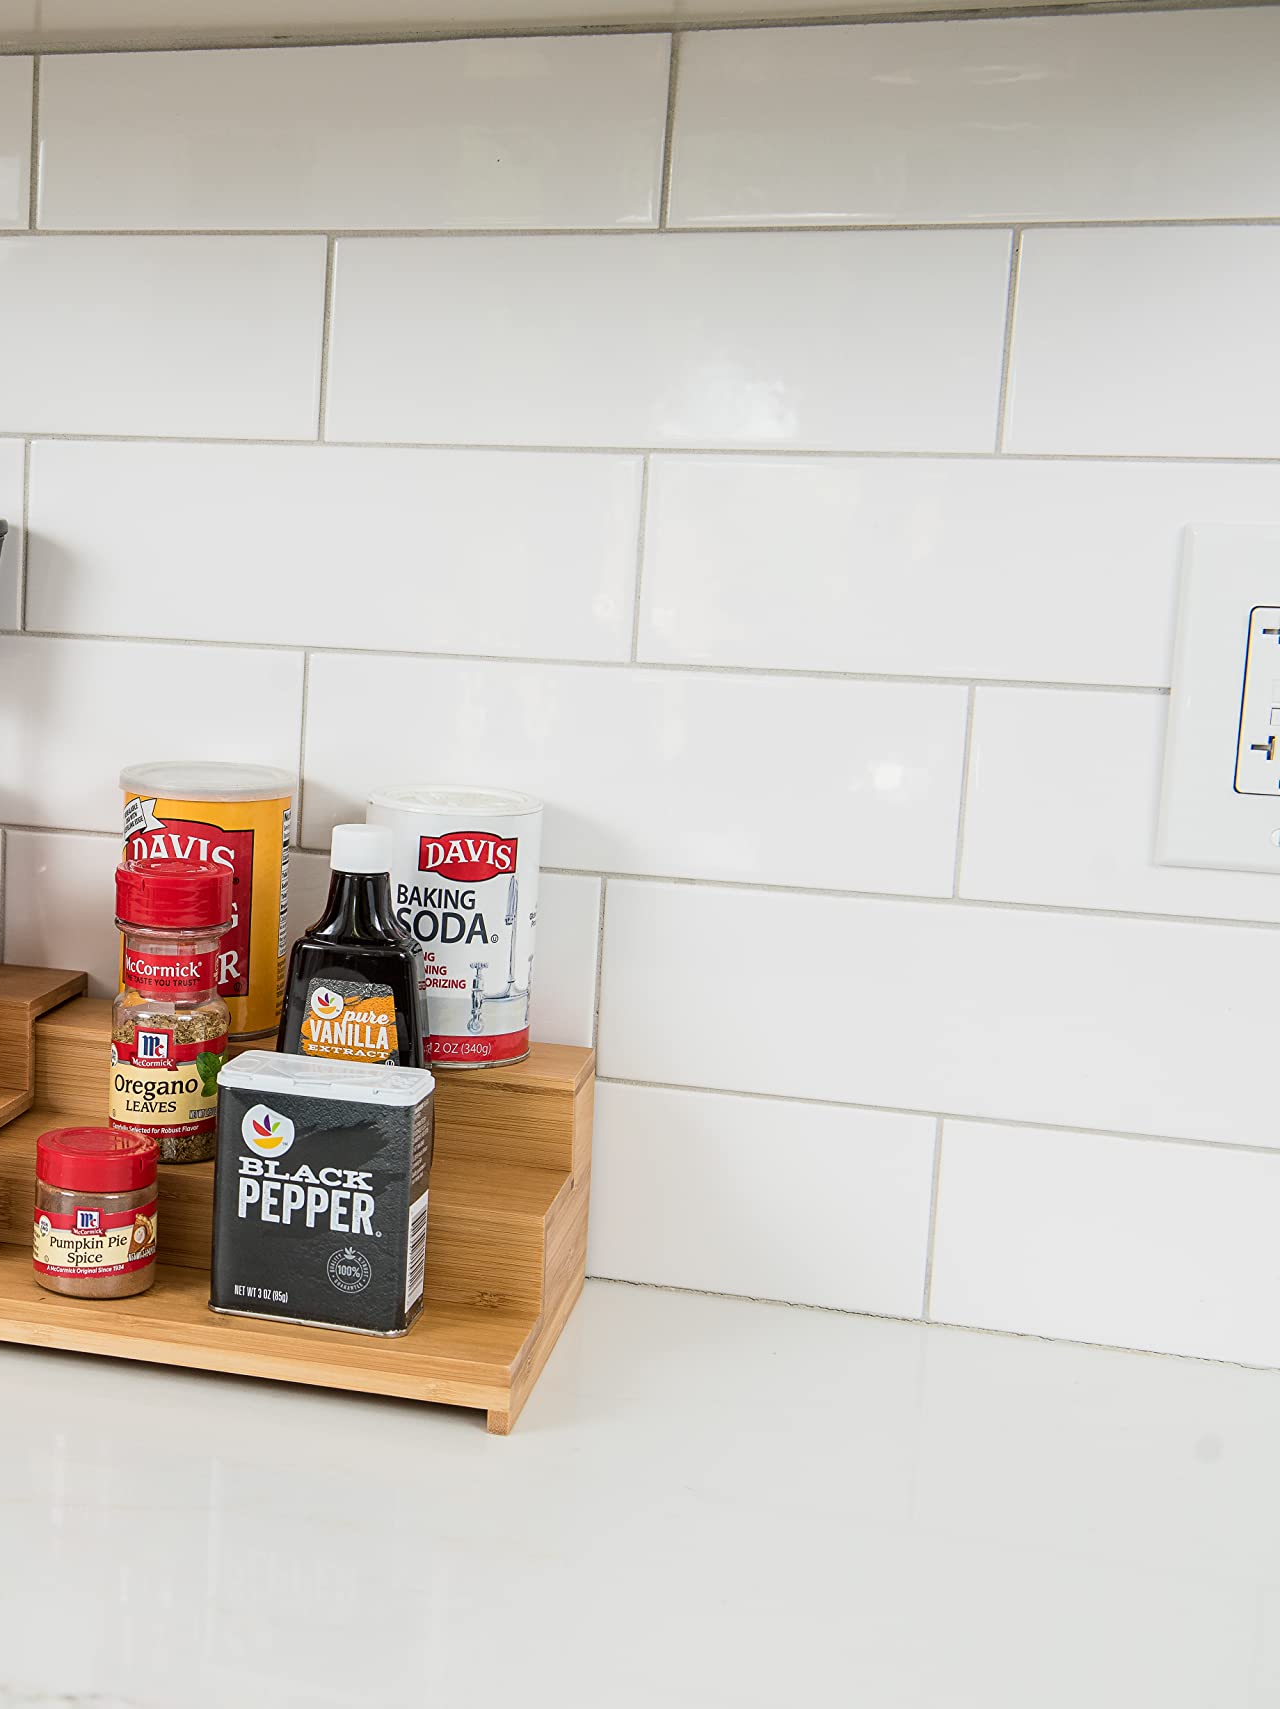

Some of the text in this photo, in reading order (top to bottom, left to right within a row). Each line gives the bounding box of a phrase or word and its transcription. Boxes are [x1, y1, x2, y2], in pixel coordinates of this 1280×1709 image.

[132, 833, 235, 874] DAVIS
[425, 838, 512, 870] DAVIS
[396, 883, 476, 910] BAKING
[396, 907, 489, 944] SODA
[125, 953, 200, 978] McCormick
[133, 976, 152, 986] TASTE
[154, 978, 170, 987] YOU
[173, 978, 196, 987] TRUST
[341, 1010, 390, 1029] pure
[309, 1019, 389, 1050] VANILLA
[307, 1043, 389, 1059] EXTRACT
[442, 1042, 459, 1054] OZ
[461, 1042, 492, 1057] (340g)
[131, 1056, 173, 1067] McCormick
[114, 1073, 198, 1101] Oregano
[125, 1100, 177, 1113] LEAVES
[128, 1124, 199, 1134] Selected for Robust Flavor
[238, 1156, 373, 1191] BLACK
[238, 1176, 375, 1236] PEPPER
[49, 1236, 104, 1252] Pumpkin
[108, 1234, 128, 1248] Pie
[67, 1252, 103, 1267] Spice
[77, 1267, 98, 1275] Original
[337, 1264, 361, 1278] 100%
[234, 1284, 288, 1304] NET WT 3 OZ (85g)
